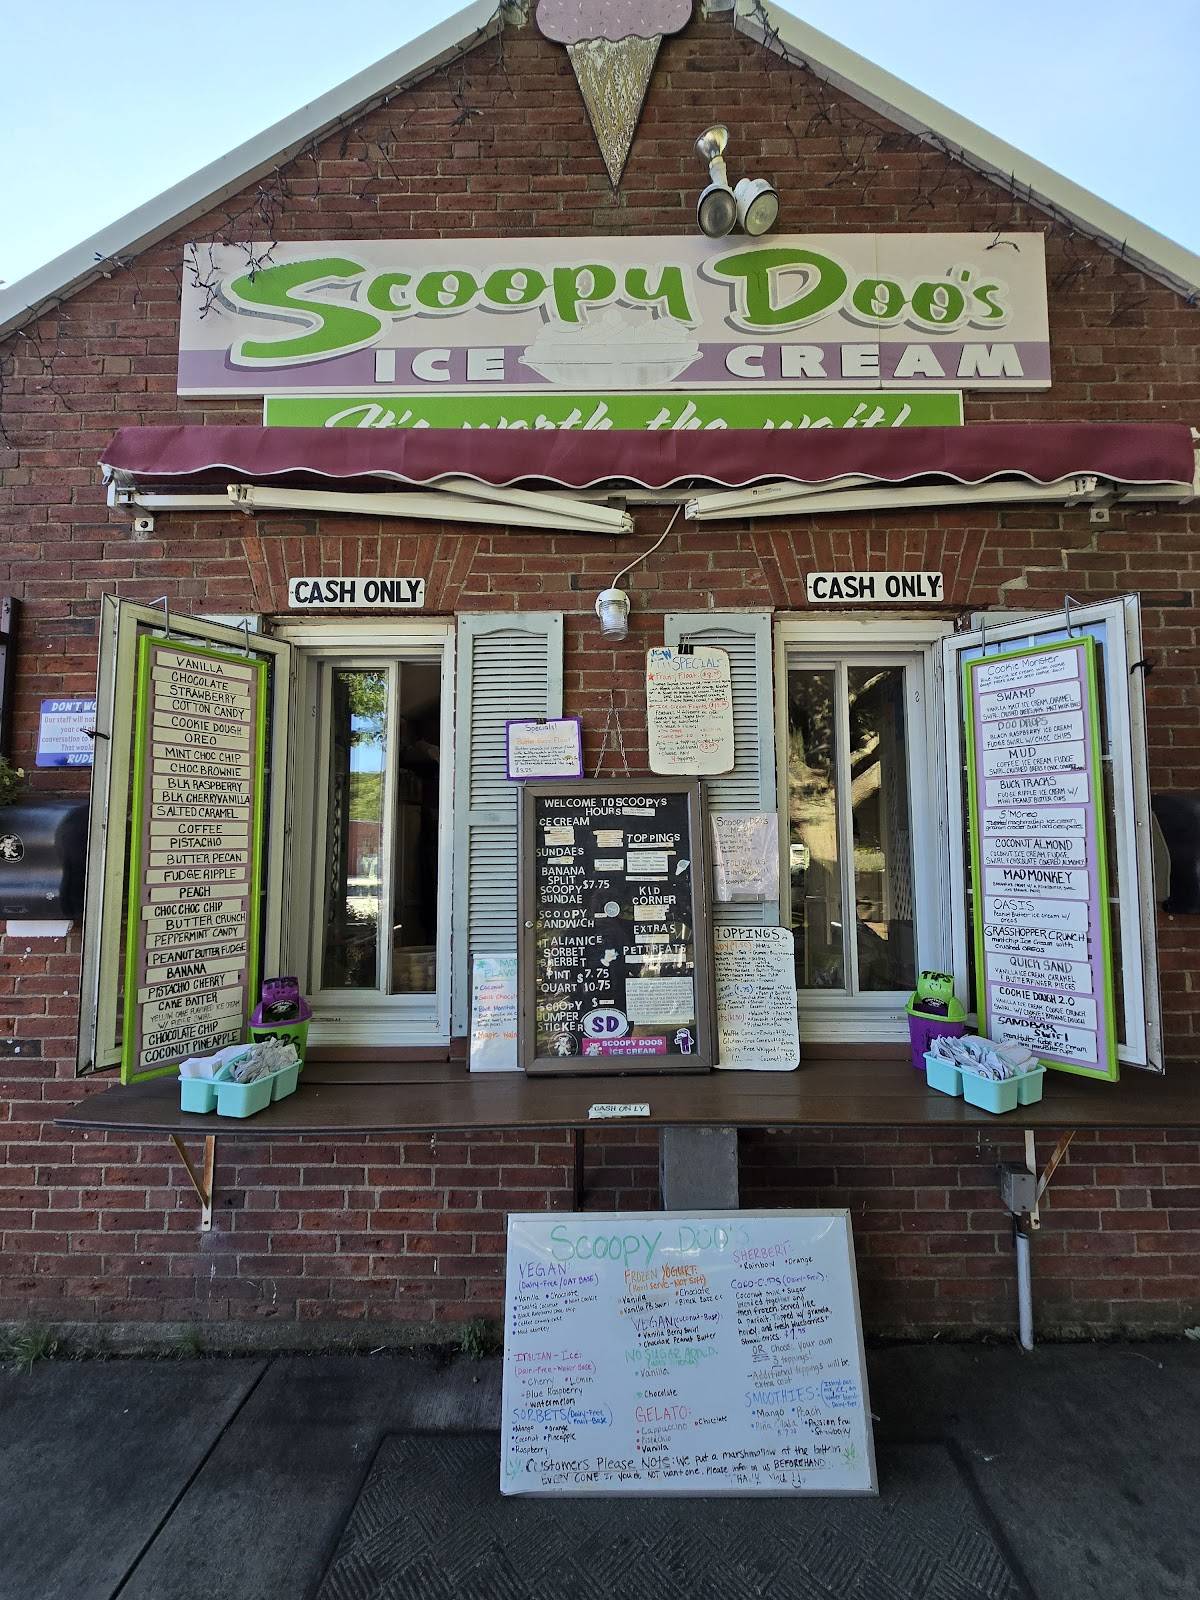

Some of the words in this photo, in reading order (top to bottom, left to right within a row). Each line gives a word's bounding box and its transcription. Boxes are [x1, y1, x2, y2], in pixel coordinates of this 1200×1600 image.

[225, 254, 694, 362] Scoopy
[375, 347, 505, 384] ICE
[725, 342, 1025, 379] CREAM
[295, 580, 355, 603] CASH
[364, 580, 420, 603] ONLY
[813, 575, 874, 598] CASH
[886, 575, 940, 597] ONLY
[177, 657, 223, 674] VANILLA
[988, 663, 1019, 675] Cookie
[171, 671, 229, 691] CHOCOLATE
[170, 685, 236, 705] STRAWBERRY
[997, 688, 1035, 701] SWAMP
[52, 702, 81, 711] DON'T
[173, 700, 210, 714] COTTON
[214, 706, 244, 720] CANDY
[172, 716, 209, 730] COOKIE
[214, 724, 242, 736] DOUGH
[185, 733, 216, 745] OREO
[165, 747, 191, 759] MINT
[194, 751, 216, 760] CHOC
[220, 752, 241, 763] CHIP
[1009, 748, 1036, 758] MUD
[170, 763, 197, 773] CHOC
[201, 764, 241, 777] BROWNIE
[168, 778, 190, 789] BLK
[1000, 779, 1020, 789] BUCK
[1021, 777, 1056, 788] TRACKS
[163, 791, 182, 802] BLK
[544, 799, 596, 807] WELCOME
[601, 798, 614, 806] TO
[157, 806, 196, 816] SALTED
[199, 808, 238, 818] CARAMEL
[586, 808, 621, 816] HOURS
[553, 817, 589, 826] CREAM
[178, 824, 222, 833] COFFEE
[170, 838, 222, 848] PISTACHIO
[627, 833, 680, 842] TOPPINGS
[996, 839, 1032, 847] COCONUT
[1034, 840, 1072, 850] ALMOND
[536, 847, 584, 857] SUNDAES
[167, 854, 209, 864] BUTTER
[213, 853, 241, 863] PECAN
[164, 870, 201, 882] FUDGE
[204, 869, 237, 879] RIPPLE
[542, 867, 585, 875] BANANA
[1004, 870, 1026, 880] MAD
[1028, 871, 1072, 883] MONKEY
[548, 876, 576, 884] SPLIT
[583, 880, 610, 889] $7.75
[180, 886, 211, 898] PEACH
[540, 885, 582, 894] SCOOPY
[639, 887, 660, 895] KID
[542, 895, 582, 903] SUNDAE
[632, 895, 676, 905] CORNER
[994, 899, 1034, 911] OASIS
[155, 906, 177, 917] CHOC
[178, 904, 200, 914] CHOC
[204, 902, 223, 912] CHIP
[540, 909, 587, 919] SCOOPY
[166, 915, 212, 930] BUTTER
[216, 913, 245, 924] CRUNCH
[537, 920, 594, 928] SANDWICH
[634, 924, 675, 934] EXTRAS
[985, 925, 1047, 940] GRASSHOPPER
[1049, 931, 1085, 941] CRUNCH
[155, 930, 208, 946] PEPPERMINT
[213, 927, 238, 937] CANDY
[153, 950, 194, 964] PEANUT
[221, 942, 246, 954] FUDGE
[544, 947, 585, 957] SORBET
[540, 958, 586, 967] SHERBET
[1010, 956, 1040, 969] QUICK
[1044, 961, 1072, 973] SAND
[167, 963, 206, 979] BANANA
[148, 981, 190, 999] PISTACHIO
[194, 974, 225, 989] CHERRY
[542, 984, 577, 992] QUART
[159, 1000, 182, 1011] CAKE
[186, 992, 218, 1006] BATTER
[1000, 987, 1030, 999] COOKIE
[1033, 992, 1056, 1004] DOUGH
[1058, 996, 1075, 1006] 2.0
[537, 1012, 578, 1022] BUMPER
[538, 1022, 583, 1031] STICKER
[592, 1016, 619, 1032] SD
[149, 1026, 196, 1046] CHOCOLATE
[198, 1022, 218, 1035] CHIP
[145, 1042, 190, 1062] COCONUT
[193, 1031, 238, 1050] PINEAPPLE
[550, 1225, 662, 1267] SCOOPY
[789, 1256, 813, 1266] Orange
[757, 1409, 784, 1417] Mango
[516, 1446, 548, 1455] Raspberry
[597, 1457, 635, 1470] Please
[695, 1455, 709, 1464] put
[575, 1472, 598, 1482] CONE
